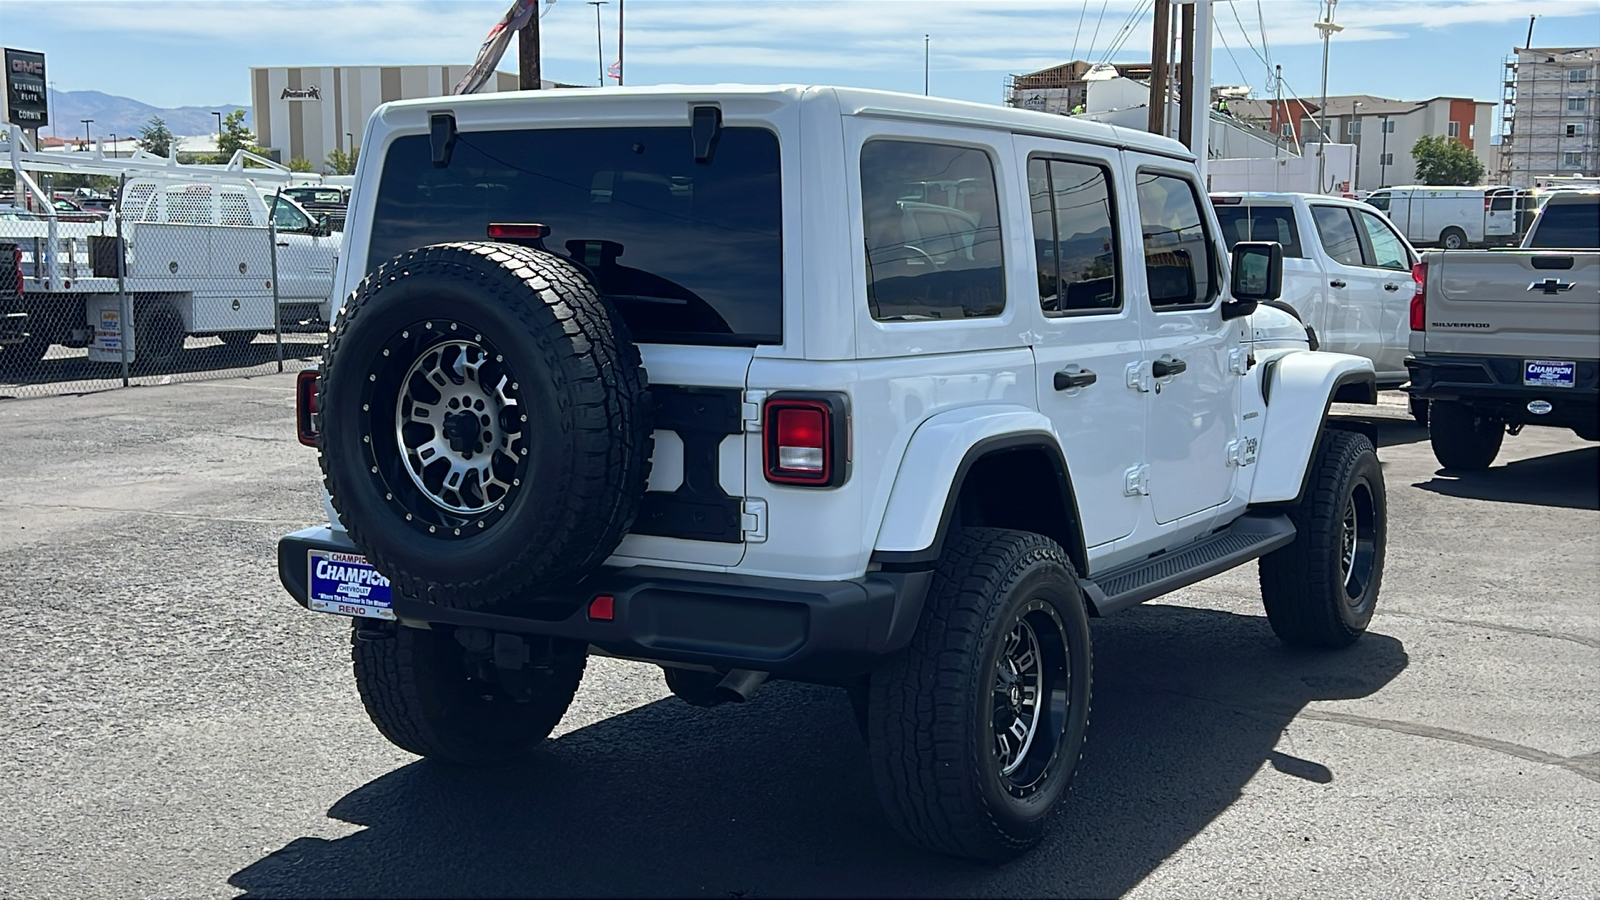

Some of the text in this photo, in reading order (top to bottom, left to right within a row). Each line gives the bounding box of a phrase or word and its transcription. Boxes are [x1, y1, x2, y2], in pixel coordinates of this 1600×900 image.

[12, 59, 43, 74] GMC
[14, 82, 43, 92] BUSINESS
[21, 92, 38, 102] ELITE
[18, 110, 42, 120] CORWIN
[1527, 364, 1572, 375] CHAMPION
[331, 553, 368, 564] CHAMPIO
[316, 560, 391, 588] CHAMPION
[339, 585, 369, 594] CHEVROLET
[338, 605, 366, 615] RENO
